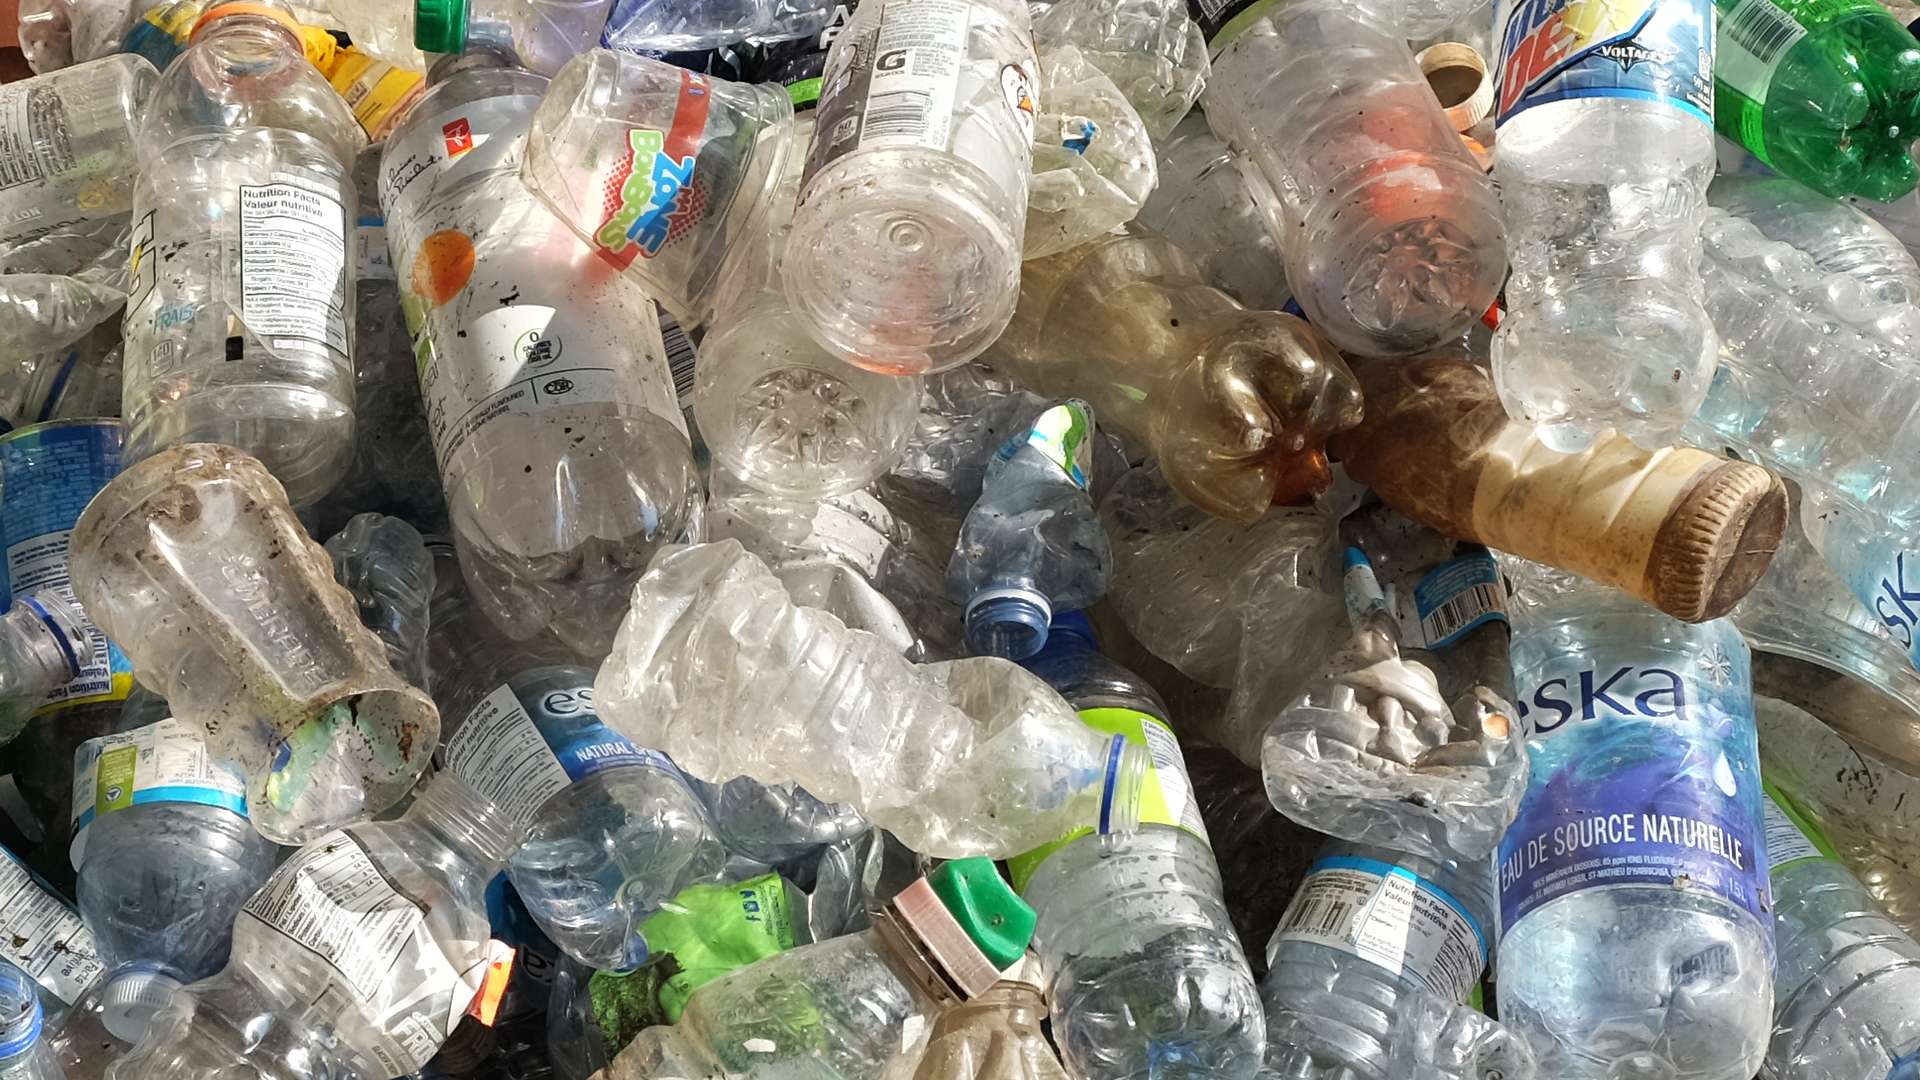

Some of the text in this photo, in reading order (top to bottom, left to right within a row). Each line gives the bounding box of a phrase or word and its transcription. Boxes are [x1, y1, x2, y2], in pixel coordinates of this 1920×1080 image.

[243, 187, 321, 206] Nutrition Facts
[243, 199, 323, 217] Valeur nutritive
[599, 129, 664, 252] BONBONS
[626, 151, 696, 255] ZONE
[529, 331, 540, 343] 0
[69, 680, 110, 694] Nutrition
[1518, 666, 1690, 738] ska
[574, 741, 633, 763] NATURAL
[1501, 850, 1524, 894] EAU
[1527, 833, 1549, 870] DE
[1553, 813, 1636, 856] SOURCE
[1642, 813, 1745, 871] NATURELLE
[1384, 889, 1448, 930] Valeur nutritive
[1388, 879, 1428, 905] Nutrition
[1428, 899, 1449, 920] Facts
